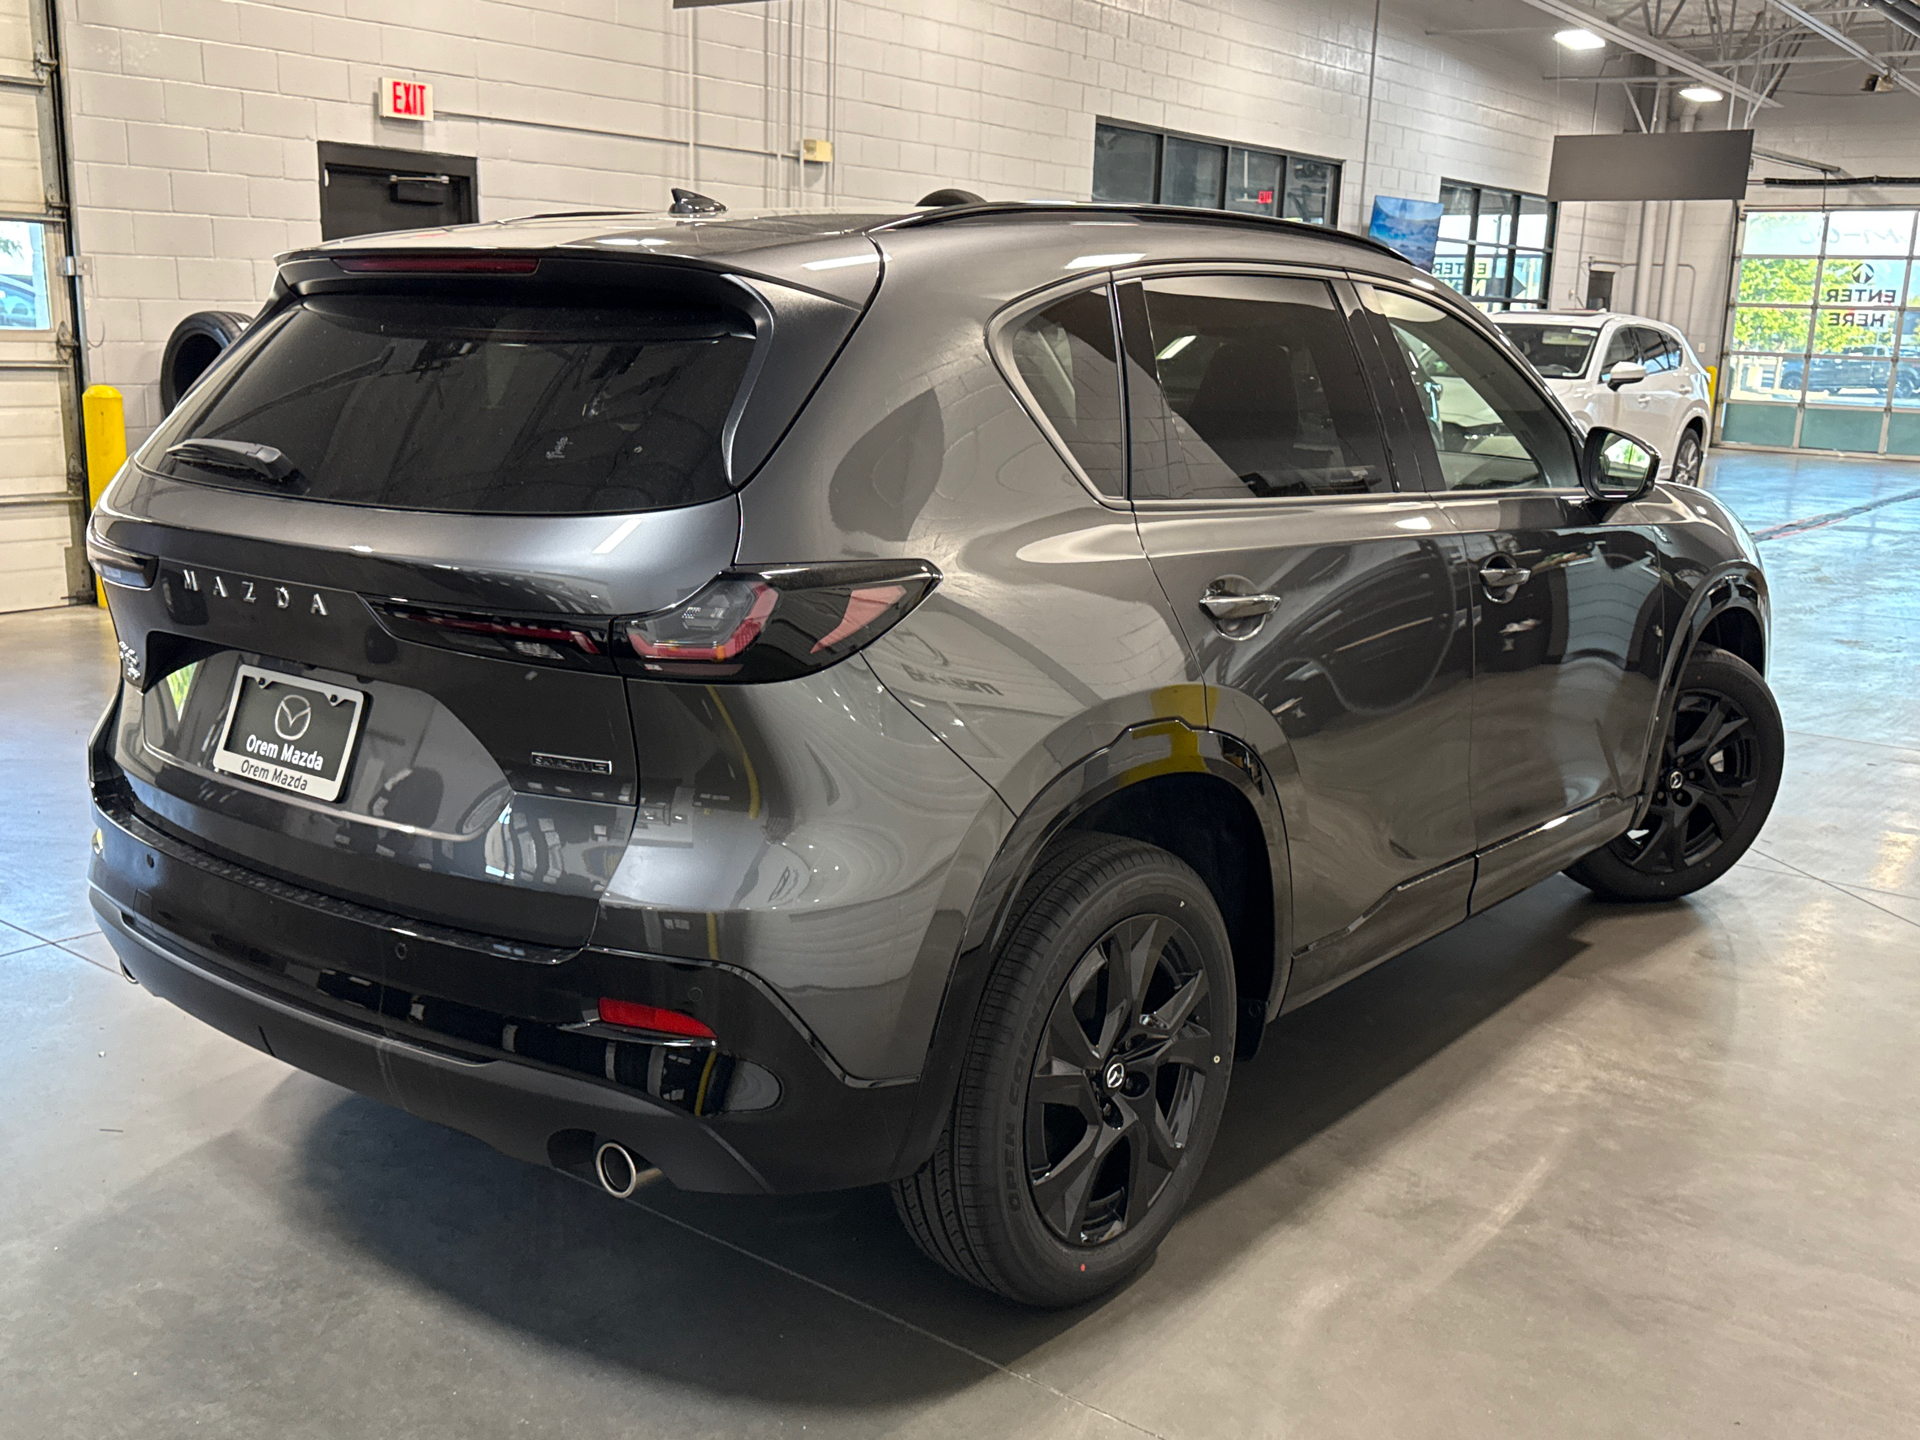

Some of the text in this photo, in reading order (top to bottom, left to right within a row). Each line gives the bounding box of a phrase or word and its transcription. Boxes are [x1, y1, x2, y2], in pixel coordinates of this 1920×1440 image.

[392, 81, 426, 116] EXIT
[183, 569, 328, 616] MAZDA
[246, 734, 324, 771] Orem Mazda
[241, 759, 308, 792] Orem Mazda
